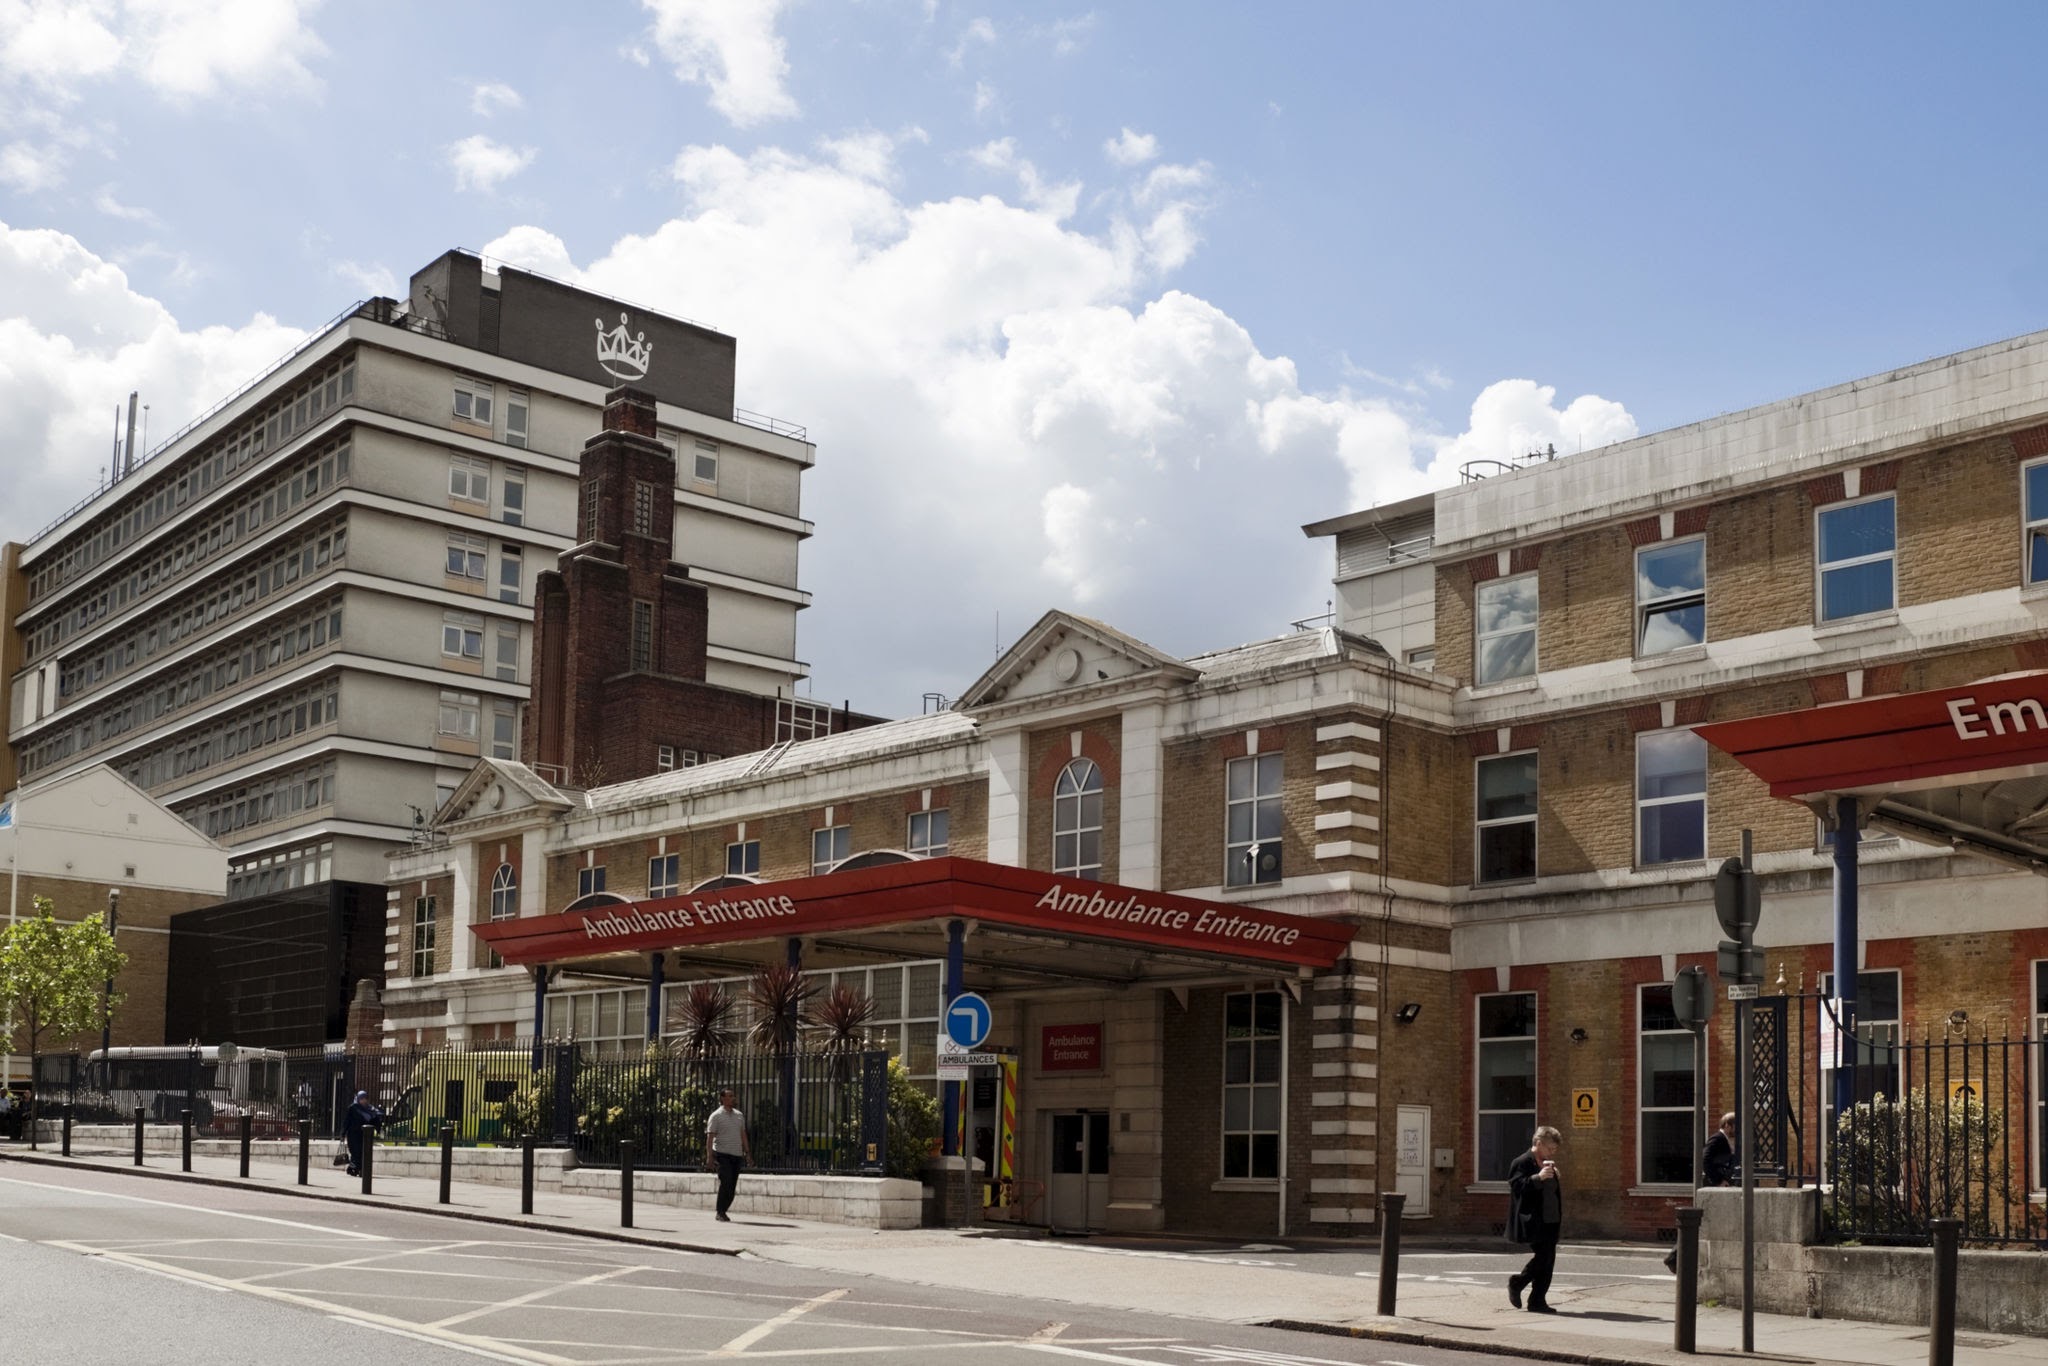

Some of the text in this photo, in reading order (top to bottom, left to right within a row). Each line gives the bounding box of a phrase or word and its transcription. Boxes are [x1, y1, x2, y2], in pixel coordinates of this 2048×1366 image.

[1945, 697, 2048, 740] Em
[581, 894, 797, 939] Ambulance Entrance
[1035, 884, 1300, 946] Ambulance Entrance
[1048, 1034, 1096, 1047] Ambulance
[942, 1055, 995, 1064] AMBULANCES
[1053, 1049, 1089, 1061] Entrance
